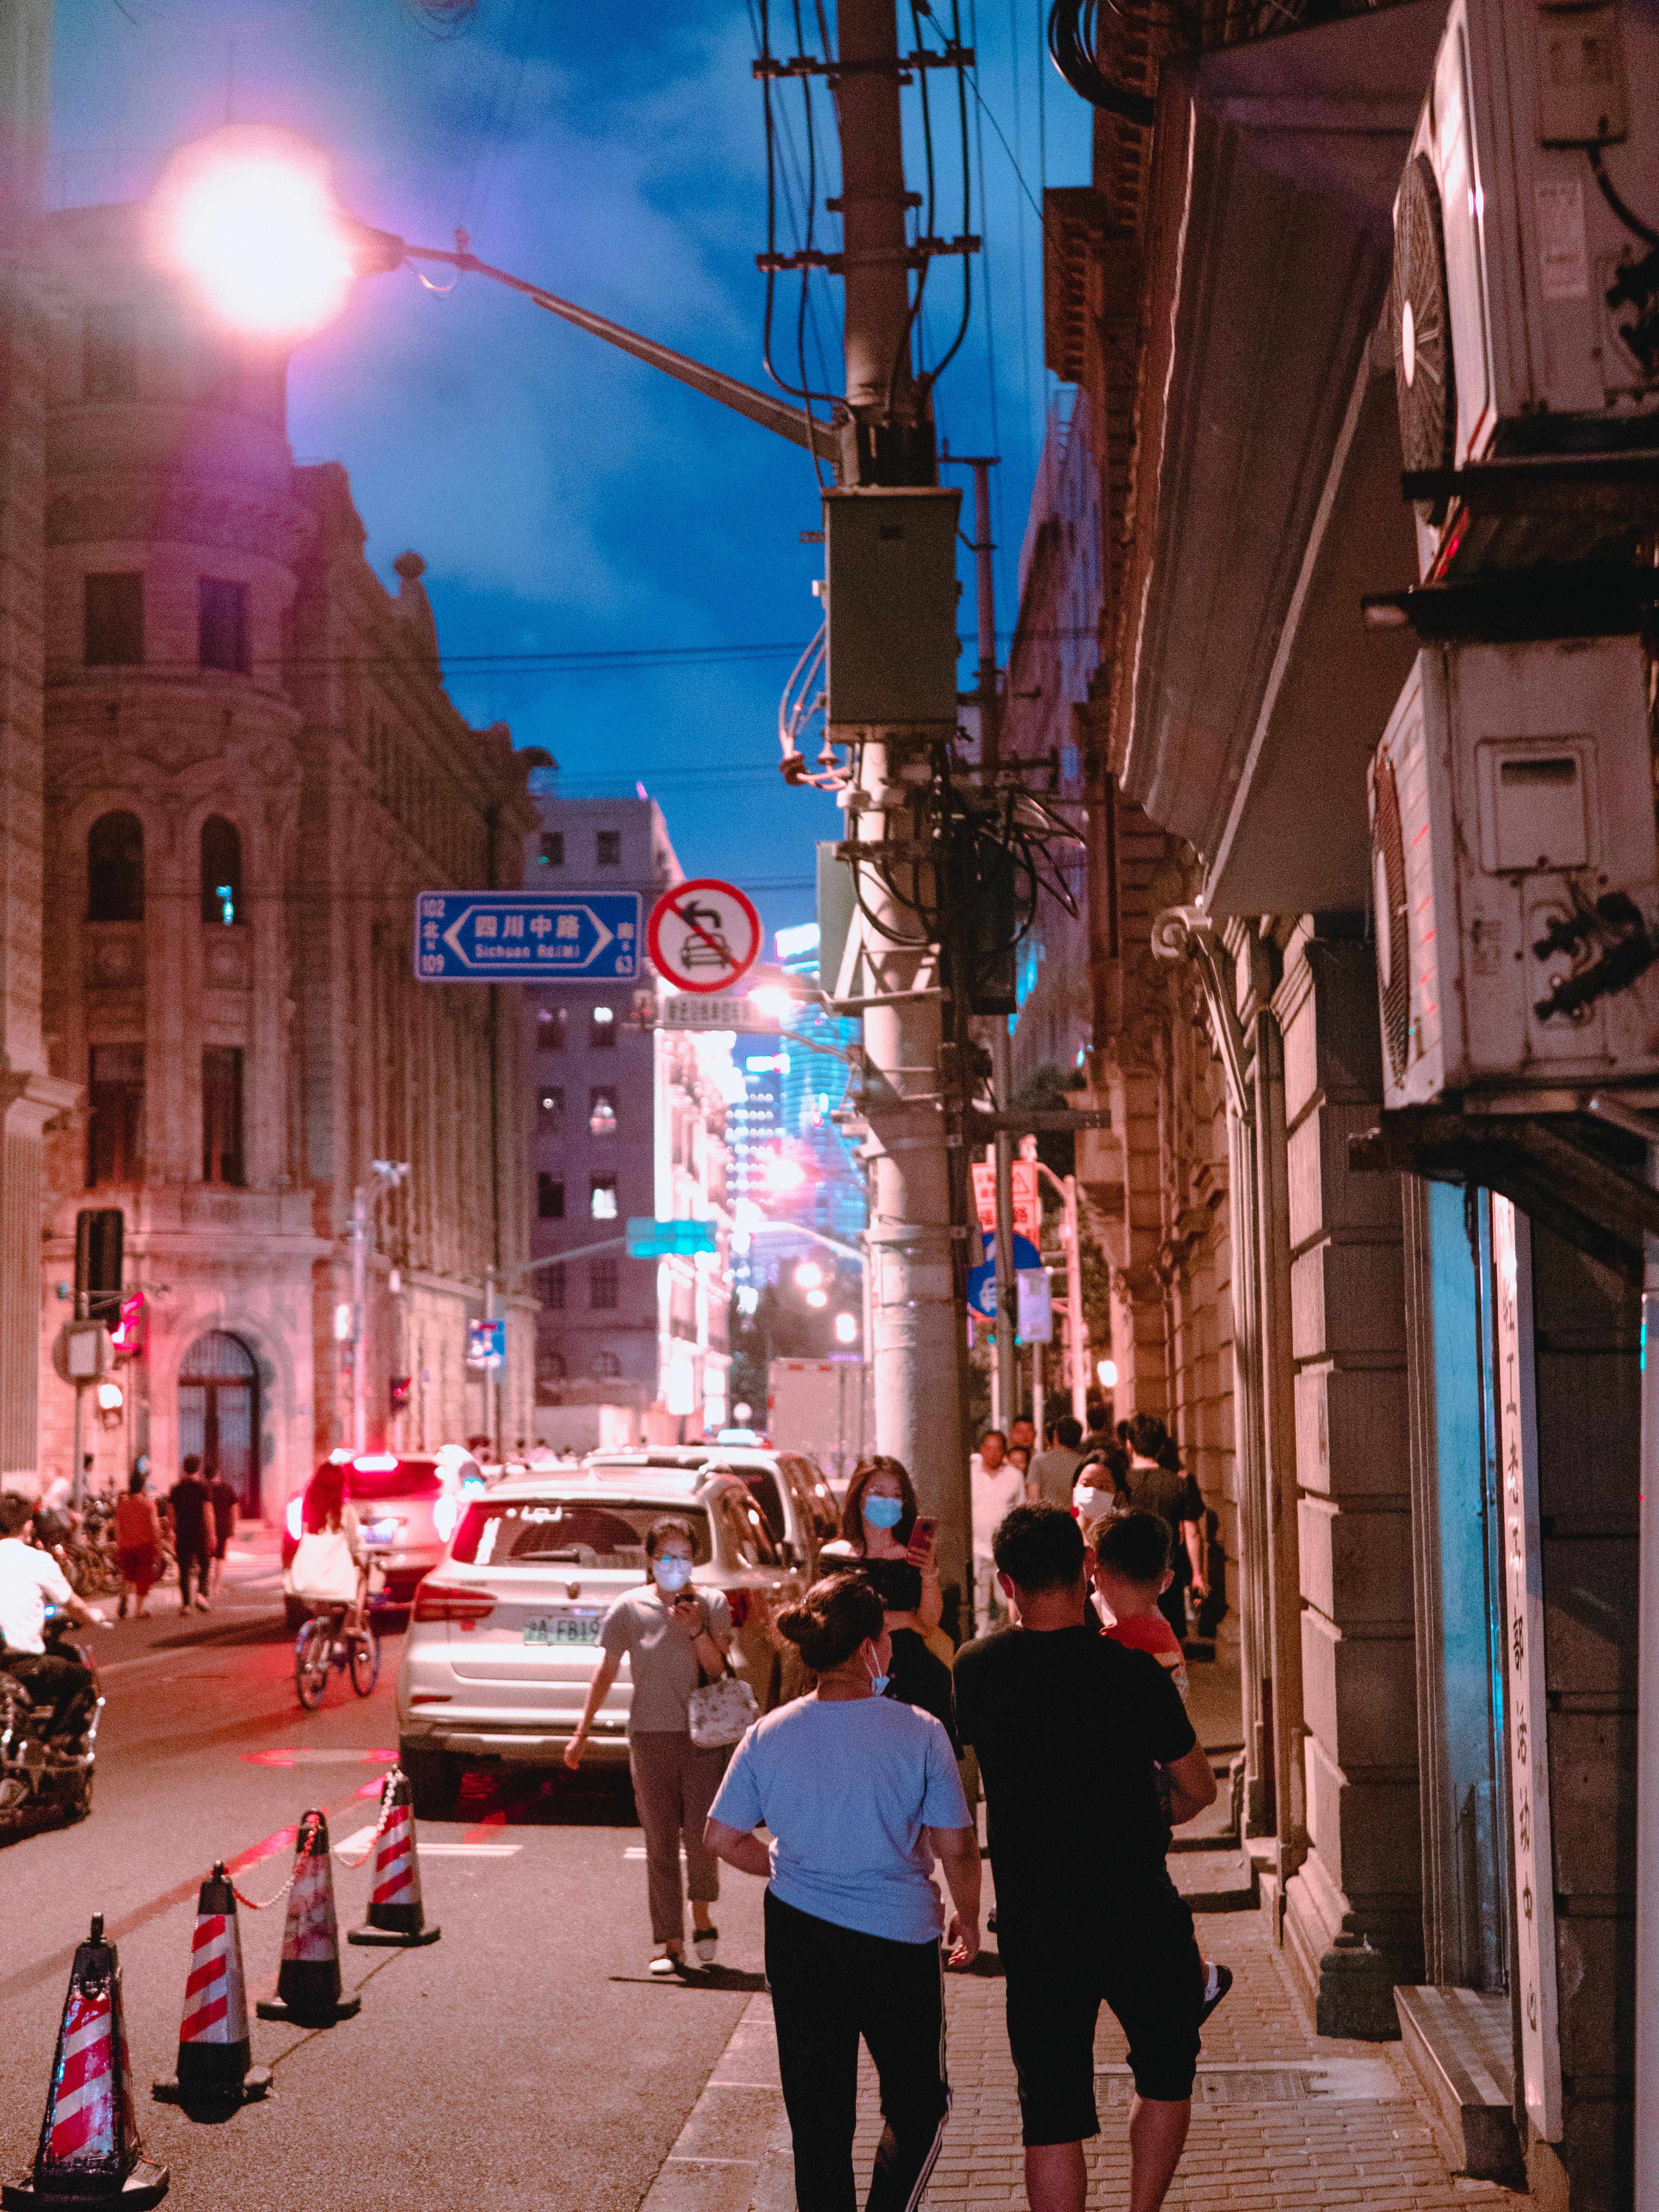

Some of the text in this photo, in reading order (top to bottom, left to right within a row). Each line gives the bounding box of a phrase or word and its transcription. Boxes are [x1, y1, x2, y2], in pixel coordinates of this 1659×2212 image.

[423, 921, 439, 939] 北
[475, 914, 579, 938] 四川中路
[617, 922, 633, 939] 南
[475, 943, 531, 958] Sichuan
